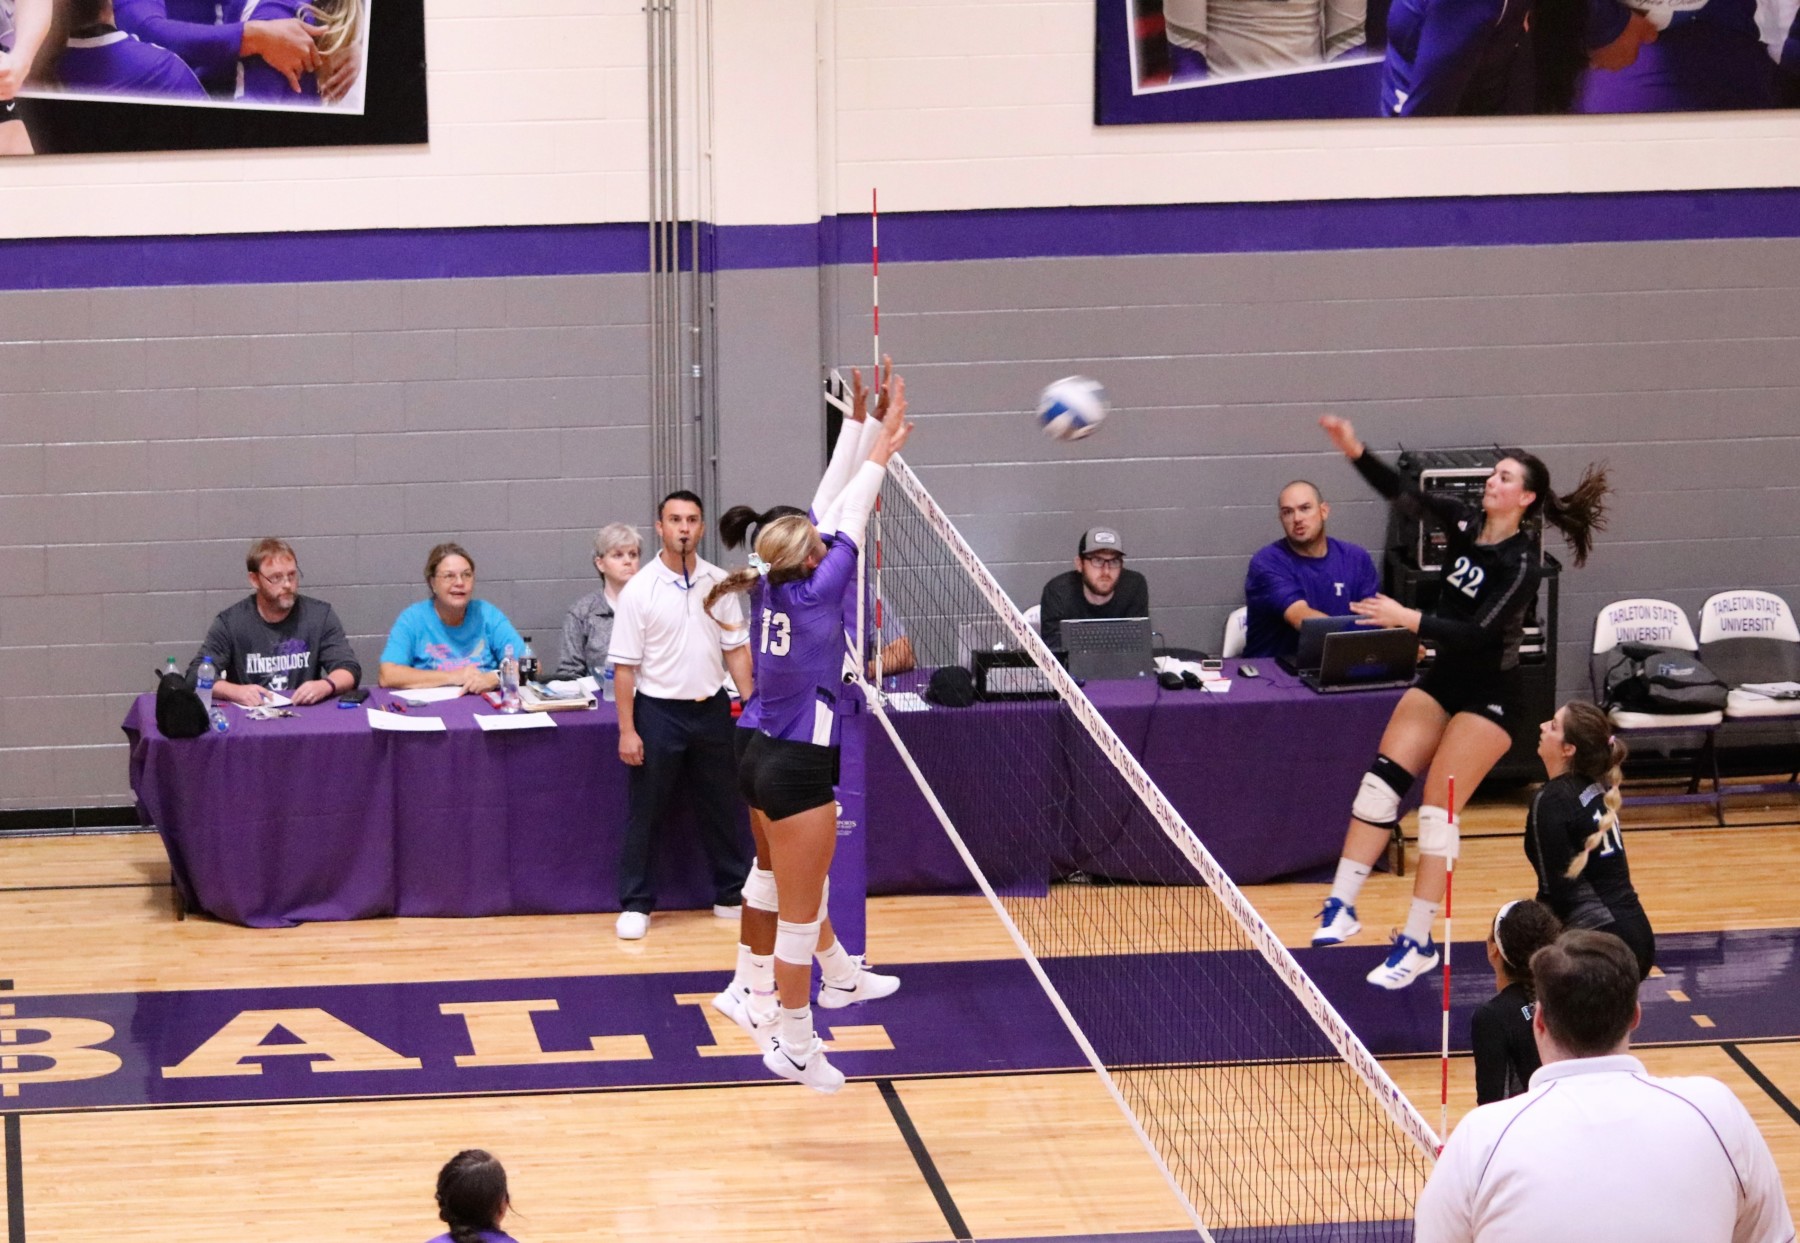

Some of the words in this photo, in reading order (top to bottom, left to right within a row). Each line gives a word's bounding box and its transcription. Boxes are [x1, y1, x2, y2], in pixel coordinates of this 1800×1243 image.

[1446, 556, 1485, 599] 22
[1333, 582, 1344, 596] T
[1608, 606, 1651, 626] TARLETON
[1653, 605, 1679, 625] STATE
[1713, 597, 1754, 617] TARLETON
[1755, 597, 1781, 617] STATE
[760, 607, 791, 657] 13
[1616, 626, 1673, 642] UNIVERSITY
[1720, 617, 1777, 632] UNIVERSITY
[246, 652, 310, 673] KINESIOLOGY
